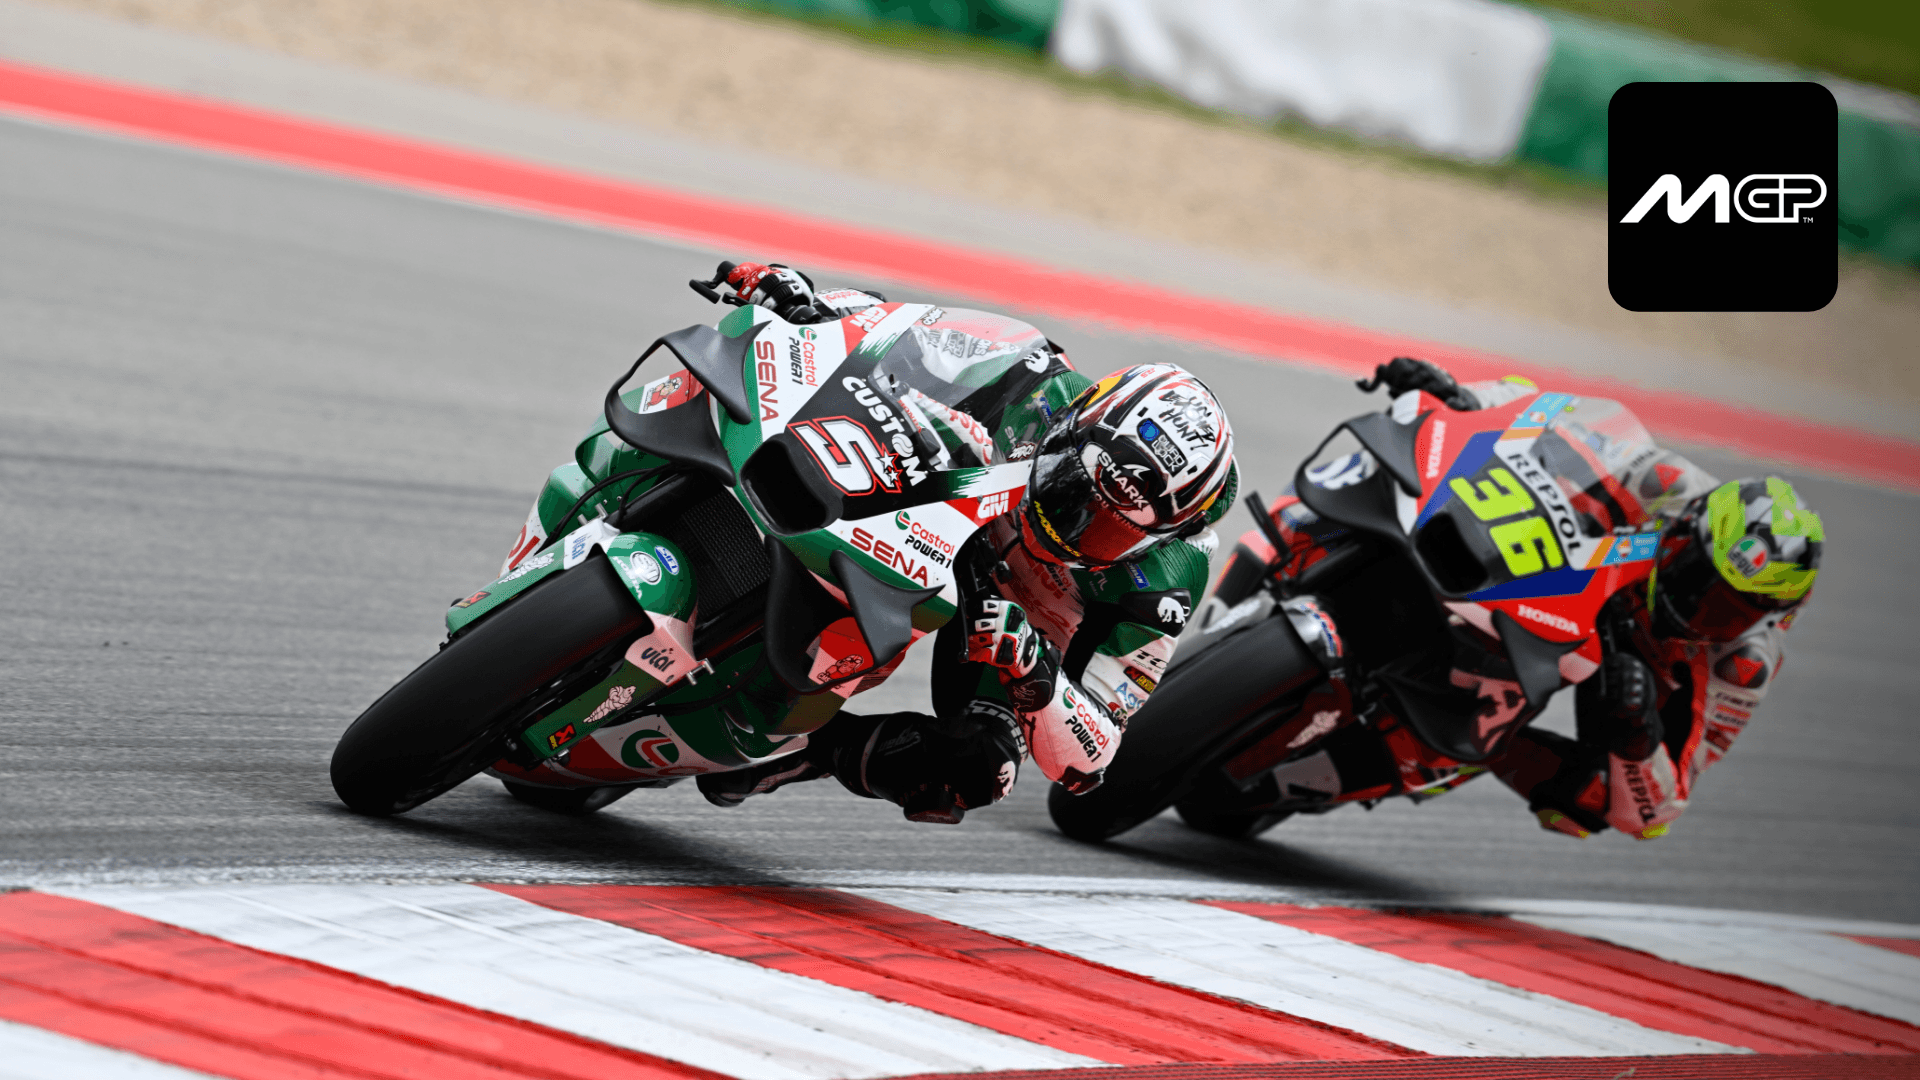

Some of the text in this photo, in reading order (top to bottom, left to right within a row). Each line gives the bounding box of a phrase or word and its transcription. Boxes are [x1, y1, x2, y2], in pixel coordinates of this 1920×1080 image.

[755, 340, 779, 422] SENA
[789, 336, 803, 385] POWER1
[802, 341, 818, 387] Castrol
[788, 416, 899, 496] 5
[976, 490, 1010, 519] GIVI
[1097, 450, 1150, 512] SHARK
[1507, 453, 1581, 552] REPSOL
[910, 520, 956, 557] Castrol
[1449, 468, 1564, 578] 36
[849, 526, 928, 588] SENA
[904, 534, 952, 571] POWER1
[1517, 603, 1580, 636] HONDA
[1065, 714, 1102, 763] POWER1
